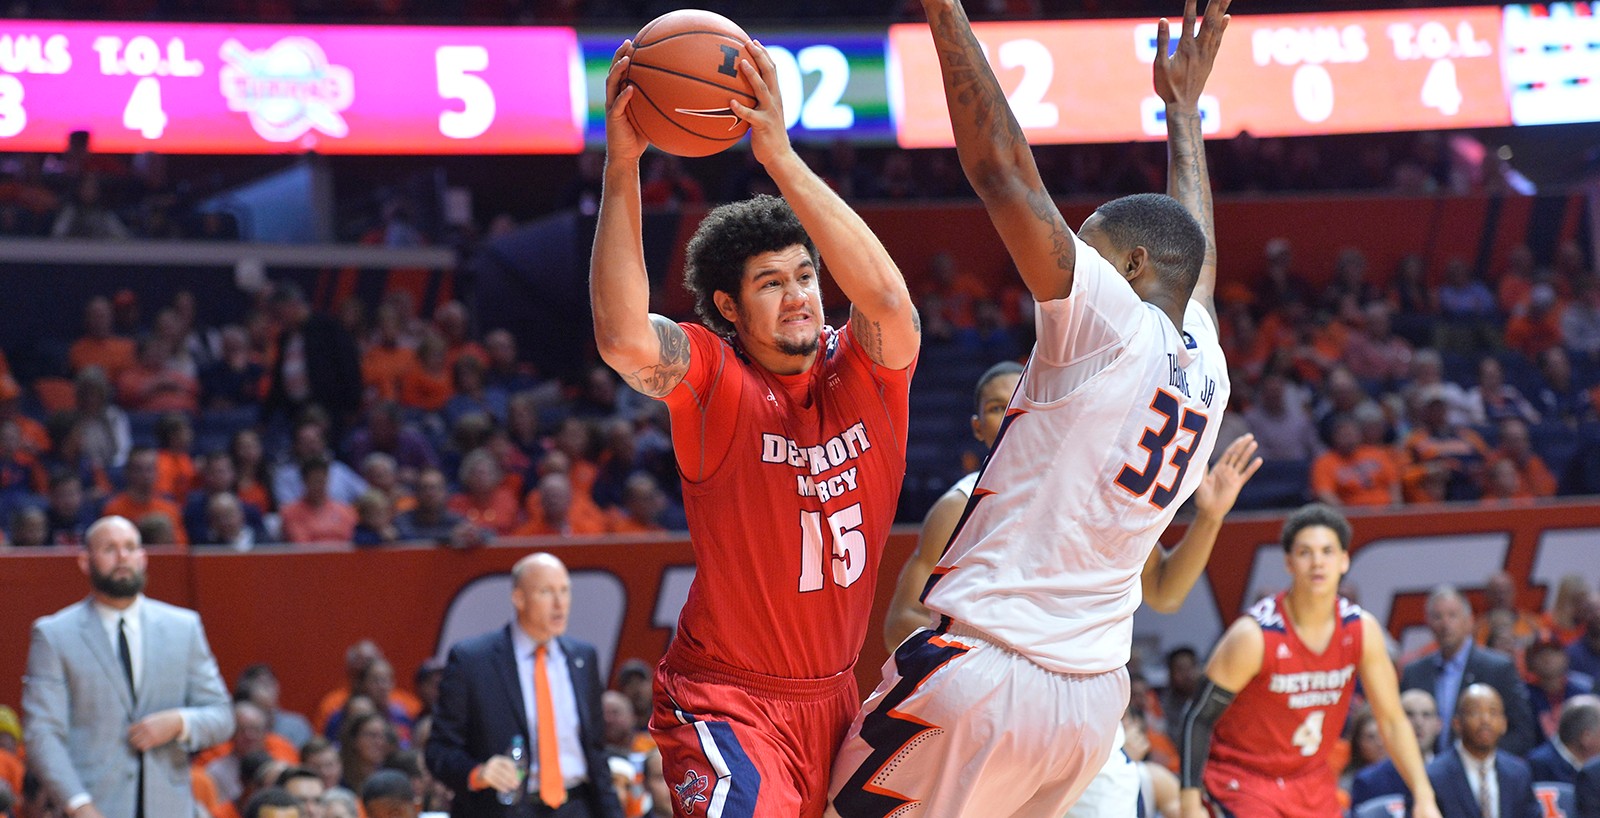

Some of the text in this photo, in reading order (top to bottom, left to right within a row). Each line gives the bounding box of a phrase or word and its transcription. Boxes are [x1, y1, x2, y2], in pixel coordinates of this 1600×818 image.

[1252, 24, 1369, 66] FOULS
[123, 77, 168, 139] 4
[436, 46, 496, 139] 5
[982, 38, 1059, 128] 2
[1293, 63, 1334, 122] 0
[1421, 58, 1463, 116] 4
[761, 419, 872, 476] DETROIT
[1113, 387, 1208, 511] 33
[797, 467, 858, 503] MRCY
[798, 502, 867, 592] 15
[1268, 664, 1356, 694] DETROIT
[1292, 710, 1326, 757] 4
